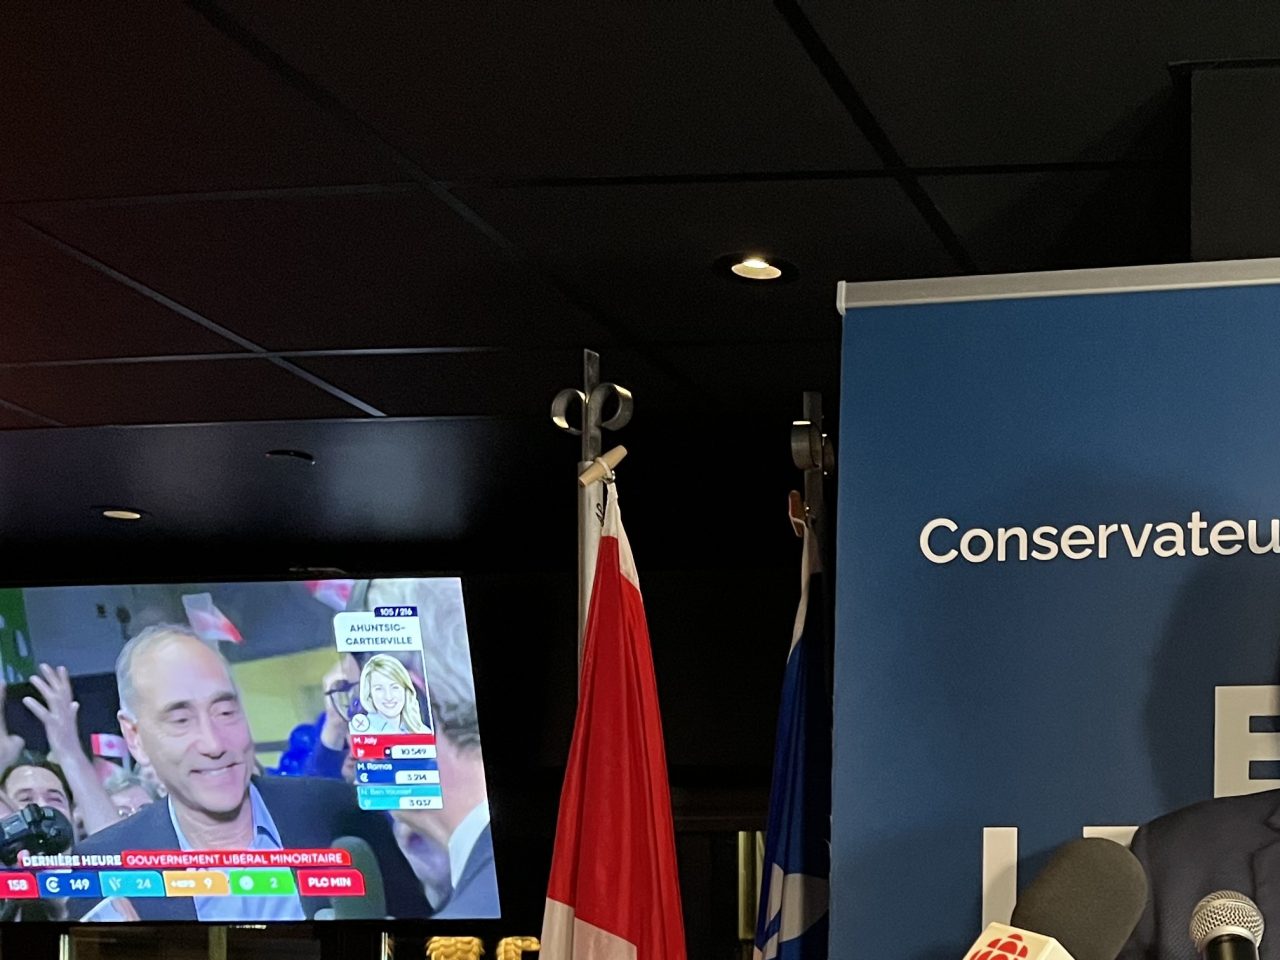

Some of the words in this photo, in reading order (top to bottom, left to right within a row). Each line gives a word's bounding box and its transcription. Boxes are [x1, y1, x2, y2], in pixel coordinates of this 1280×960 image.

[346, 637, 413, 645] CARTIERVILLE
[82, 854, 122, 866] HEURE
[126, 854, 220, 866] GOUVERNEMENT
[270, 853, 343, 863] MINORITAIRE
[69, 878, 90, 891] 149
[136, 878, 151, 890] 24
[203, 878, 212, 889] 9
[270, 878, 279, 888] 2
[330, 877, 352, 887] MIN
